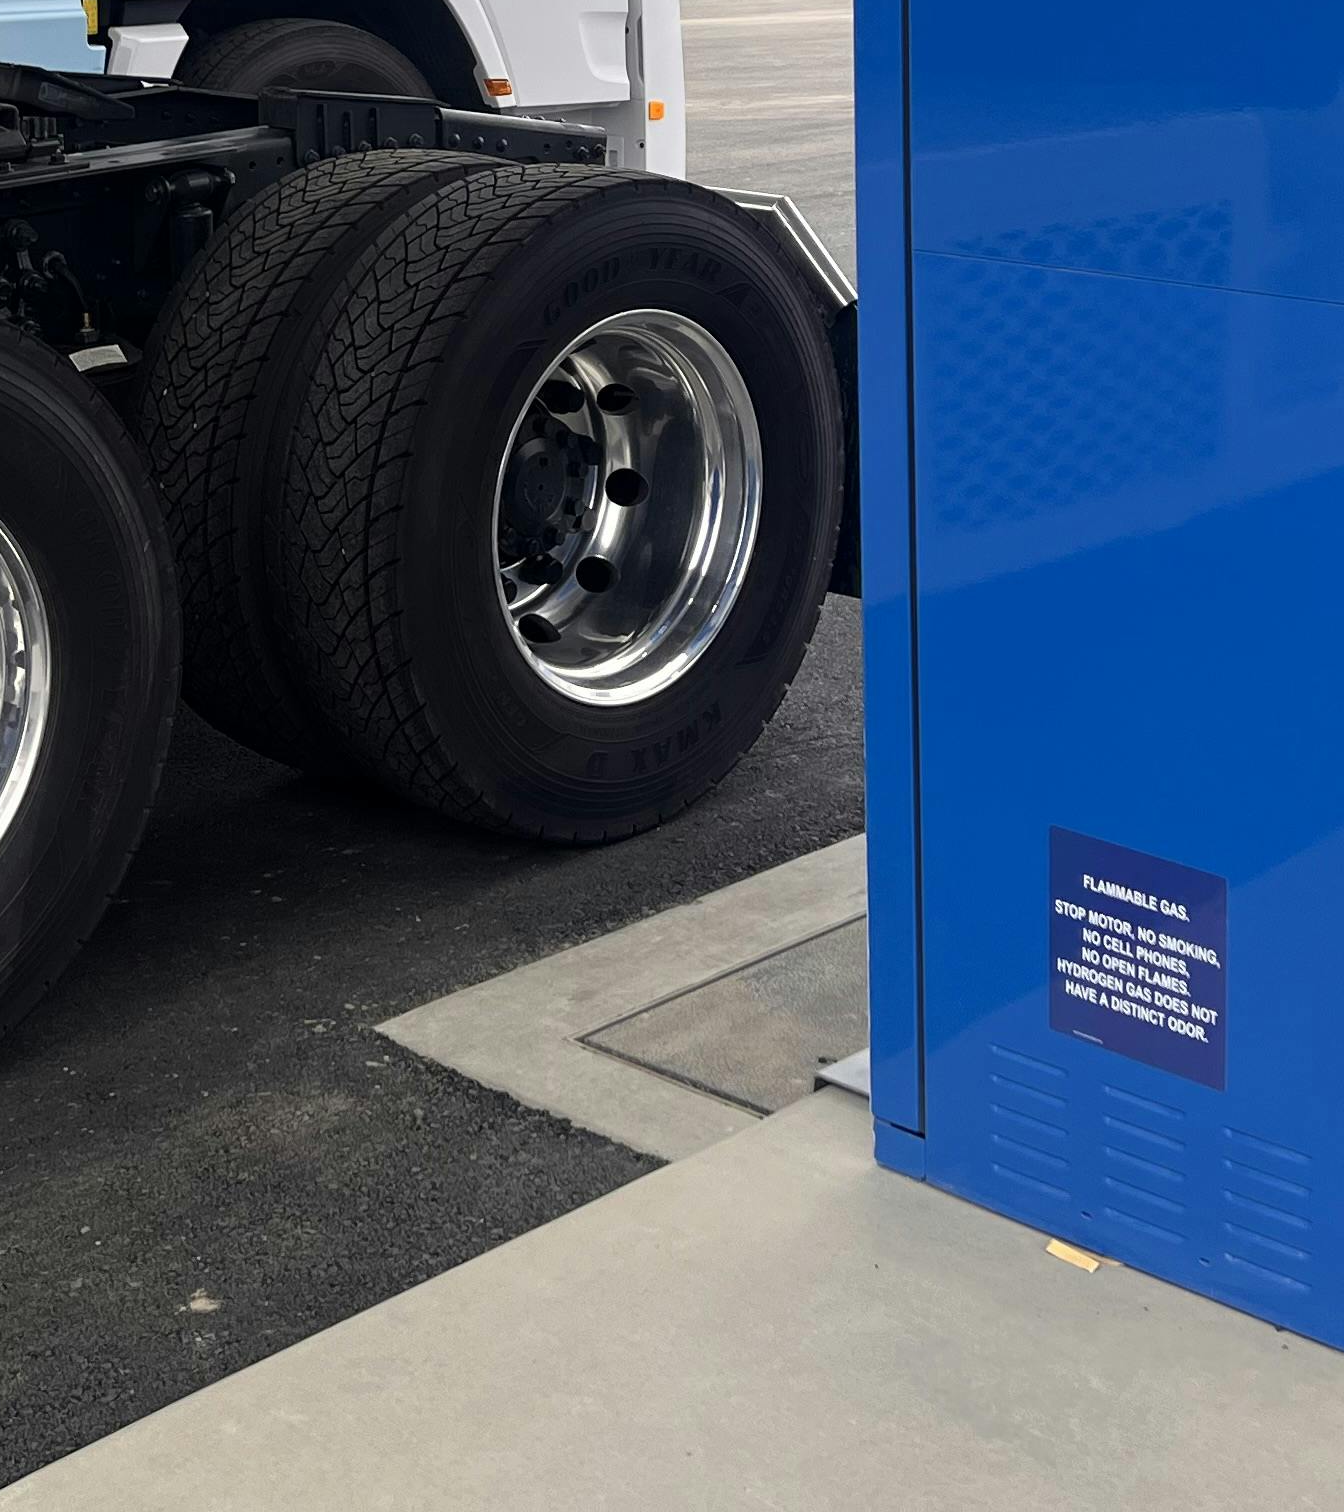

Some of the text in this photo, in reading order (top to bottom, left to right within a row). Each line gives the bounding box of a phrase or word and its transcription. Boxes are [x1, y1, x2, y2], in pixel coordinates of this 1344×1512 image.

[1083, 873, 1158, 912] FLAMMABLE
[1054, 898, 1087, 922] STOP
[1137, 926, 1157, 945] NO
[1082, 927, 1101, 947] NO
[1103, 934, 1134, 959] CELL
[1081, 946, 1100, 966] NO
[1102, 953, 1136, 978] OPEN
[1057, 957, 1218, 1026] HYDROGEN GAS DOES NOT
[1065, 979, 1101, 1006] HAVE
[1099, 991, 1110, 1009] A
[1111, 995, 1166, 1028] DISTINCT
